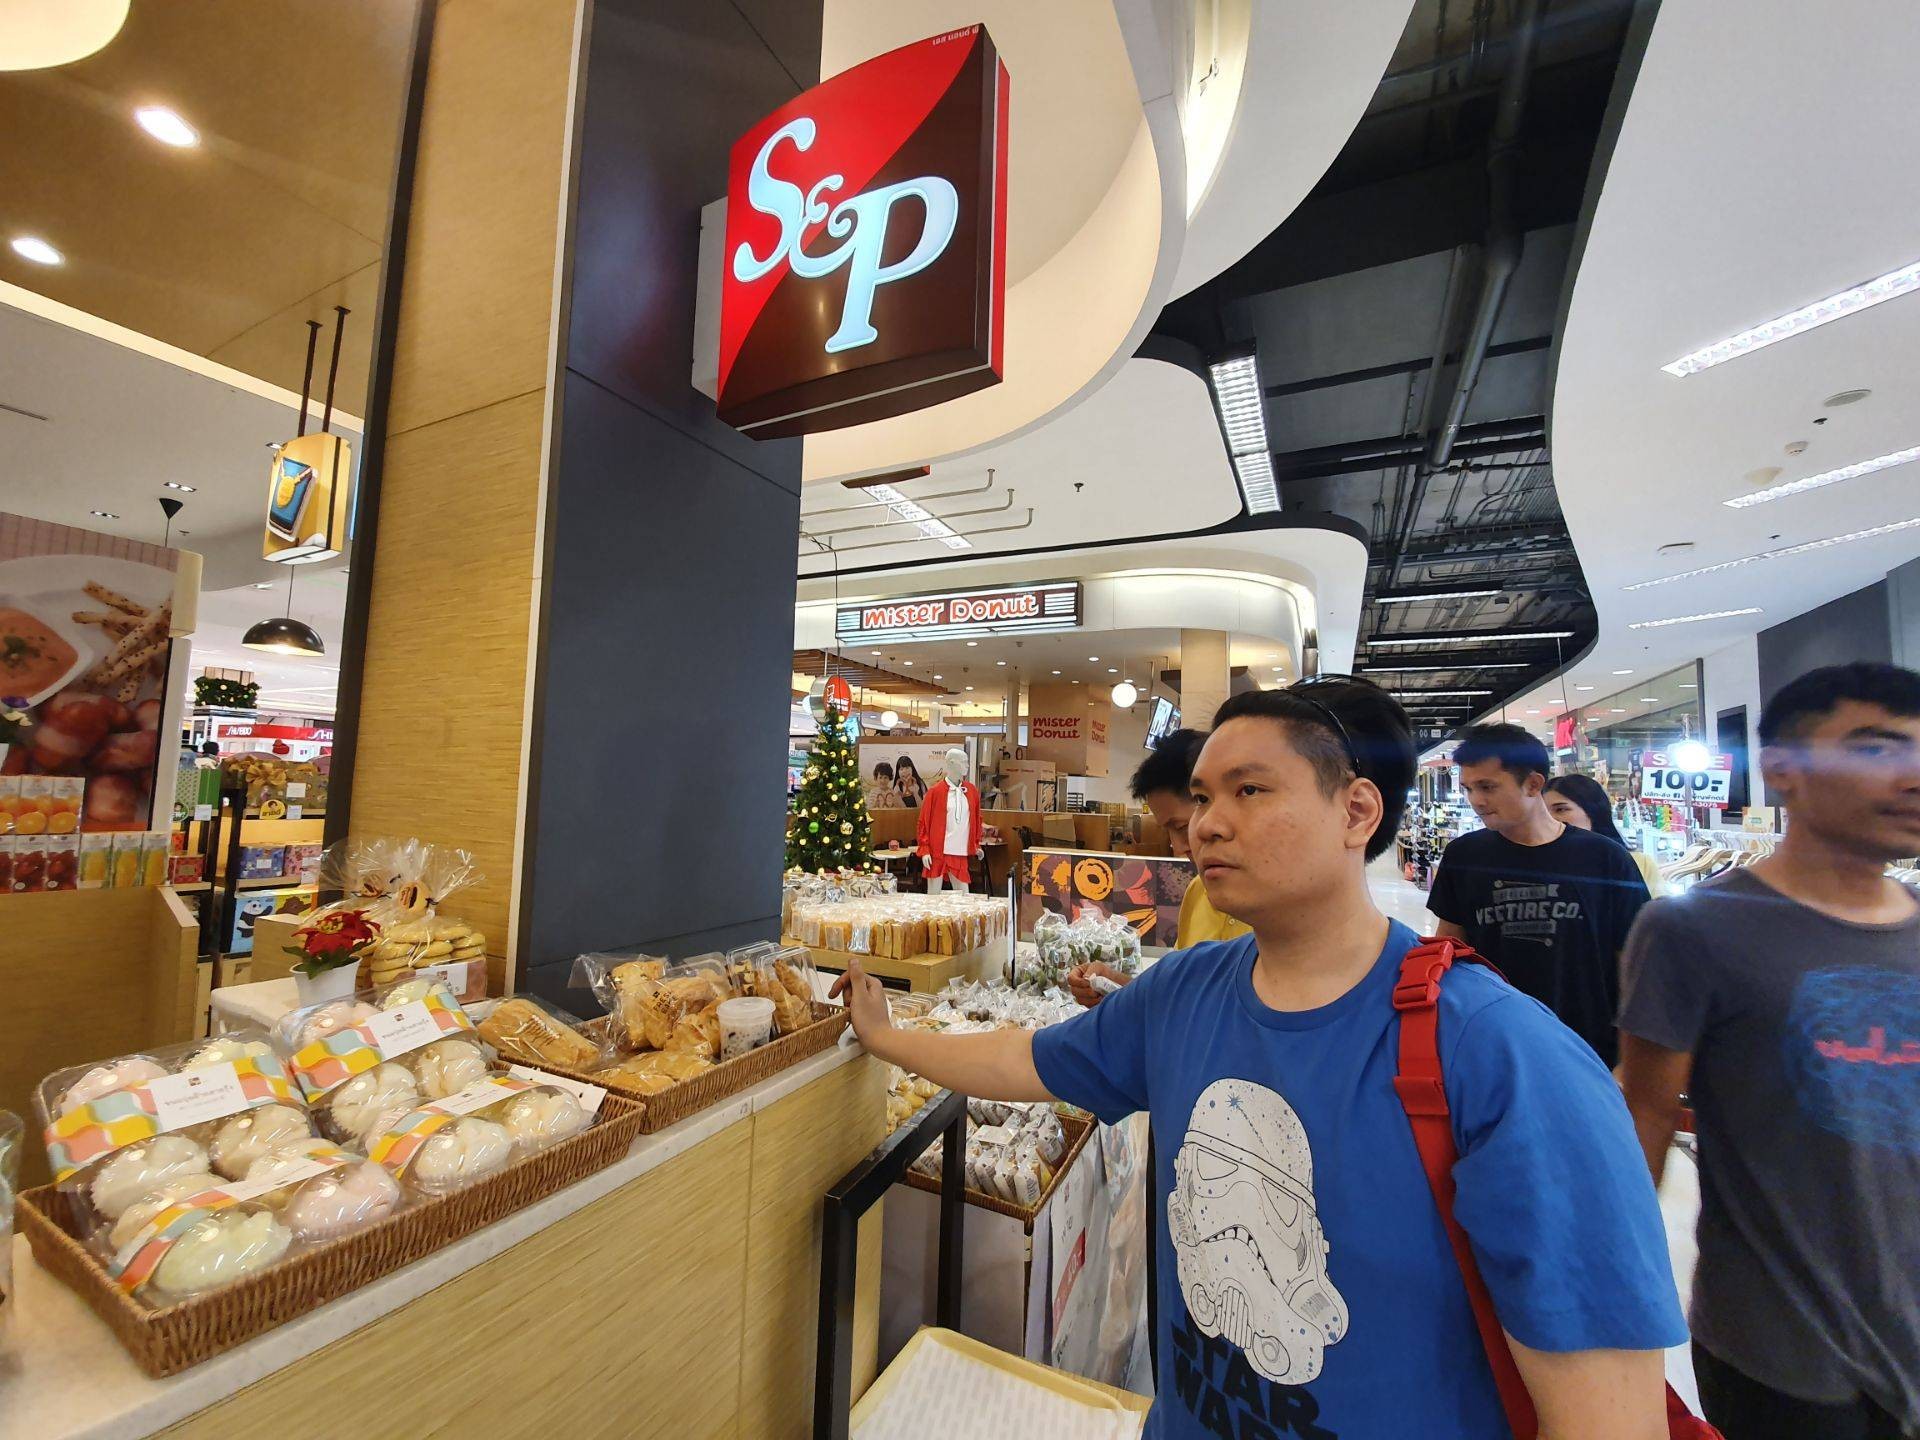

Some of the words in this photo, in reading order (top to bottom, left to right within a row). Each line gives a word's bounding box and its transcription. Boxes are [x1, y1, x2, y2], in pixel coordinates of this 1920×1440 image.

[733, 117, 959, 353] S&P
[950, 593, 1039, 623] Donut
[1033, 728, 1081, 739] Donut
[1652, 753, 1725, 769] SE
